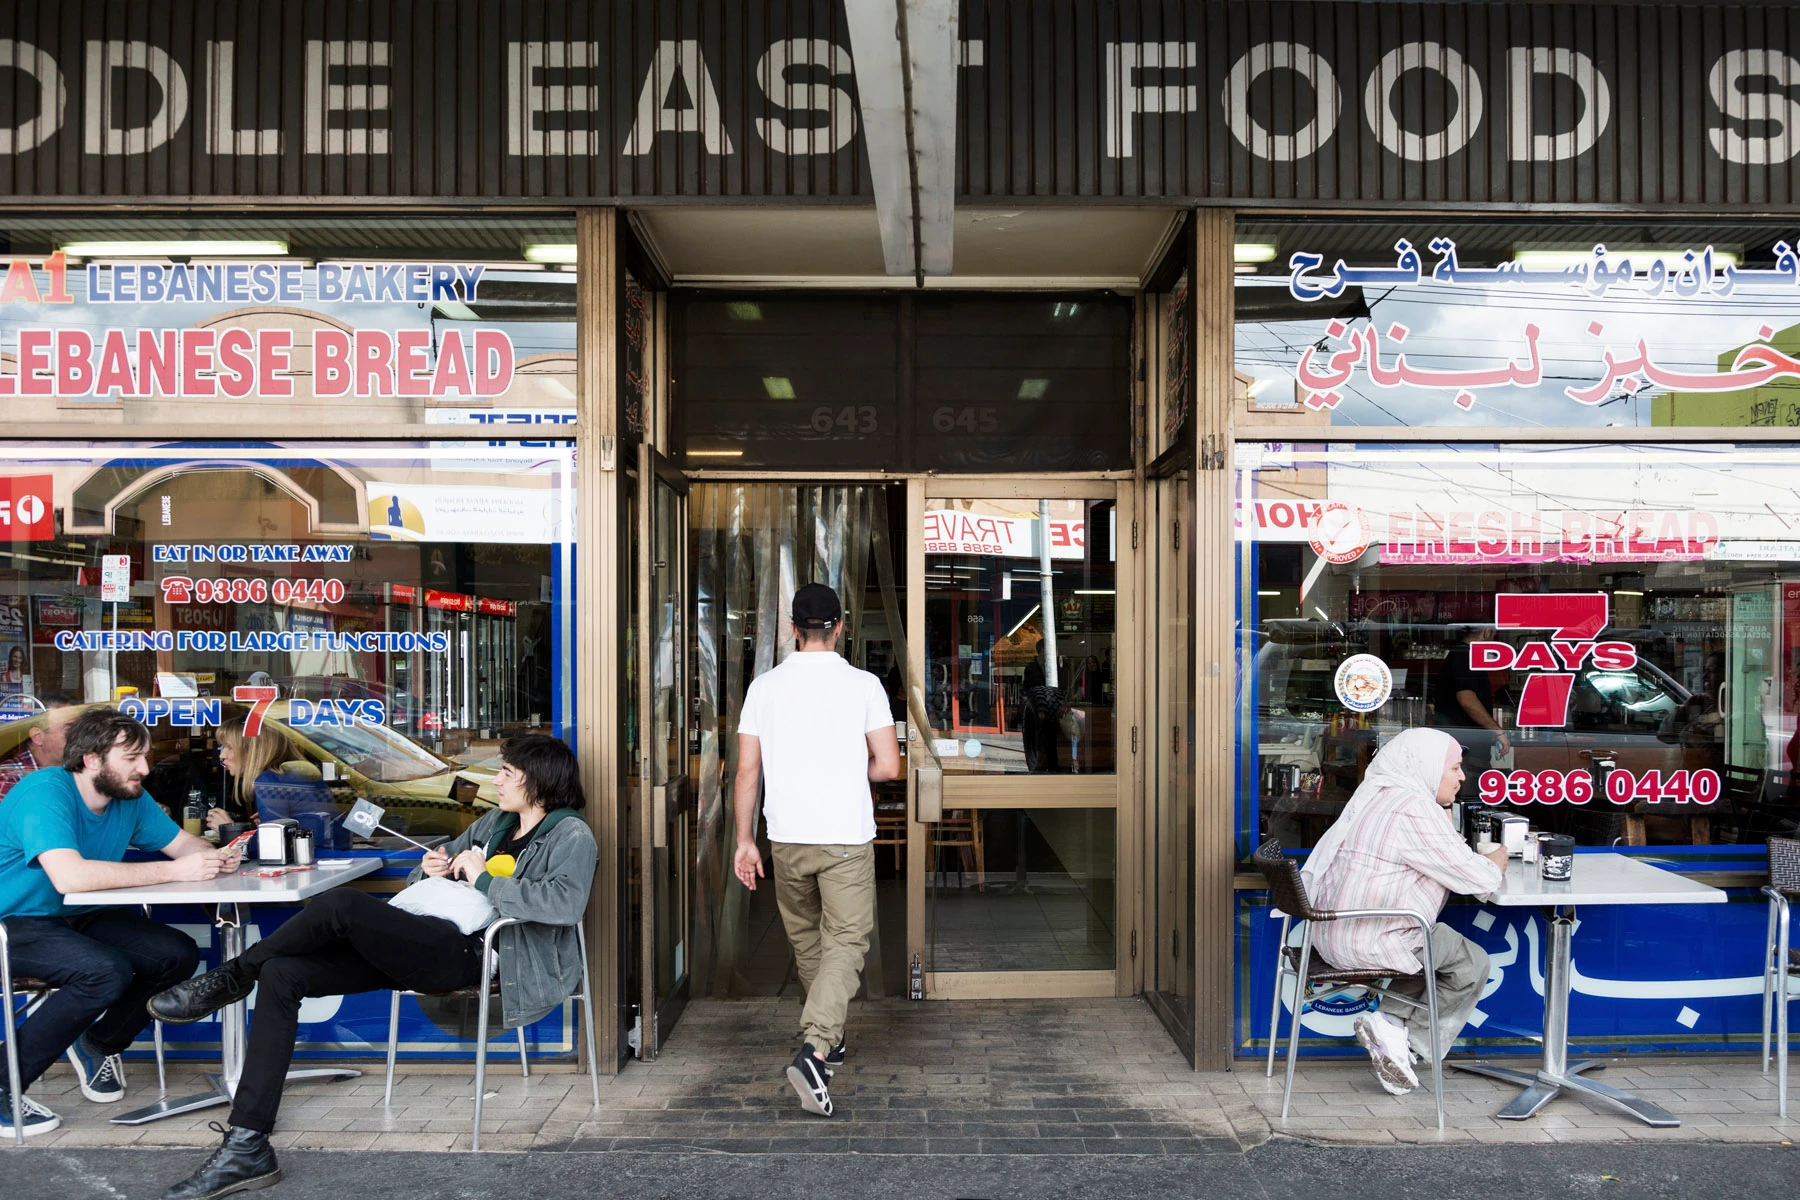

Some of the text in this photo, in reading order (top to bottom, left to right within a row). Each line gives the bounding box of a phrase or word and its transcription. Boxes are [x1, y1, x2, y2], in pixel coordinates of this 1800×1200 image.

[508, 38, 983, 155] EAS
[1106, 41, 1610, 162] FOOD
[0, 250, 486, 304] A1 LEBANESE BAKERY
[312, 328, 517, 398] BREAD
[1294, 316, 1544, 412] لبناني
[811, 406, 878, 433] 643
[932, 406, 999, 433] 645
[161, 495, 172, 526] LEBANESE
[1386, 511, 1543, 557] FRESH
[1560, 511, 1720, 557] BREAD
[153, 544, 353, 562] EAT IN OR TAKE AWAY
[195, 578, 345, 604] 9386 0440
[55, 630, 448, 652] CATERING FOR LARGE FUNCTIONS
[1469, 641, 1637, 671] DAYS
[118, 685, 386, 739] OPEN 7 DAYS
[1478, 769, 1722, 805] 9386 0440
[1314, 1002, 1367, 1014] LEBANESE BAKERY
